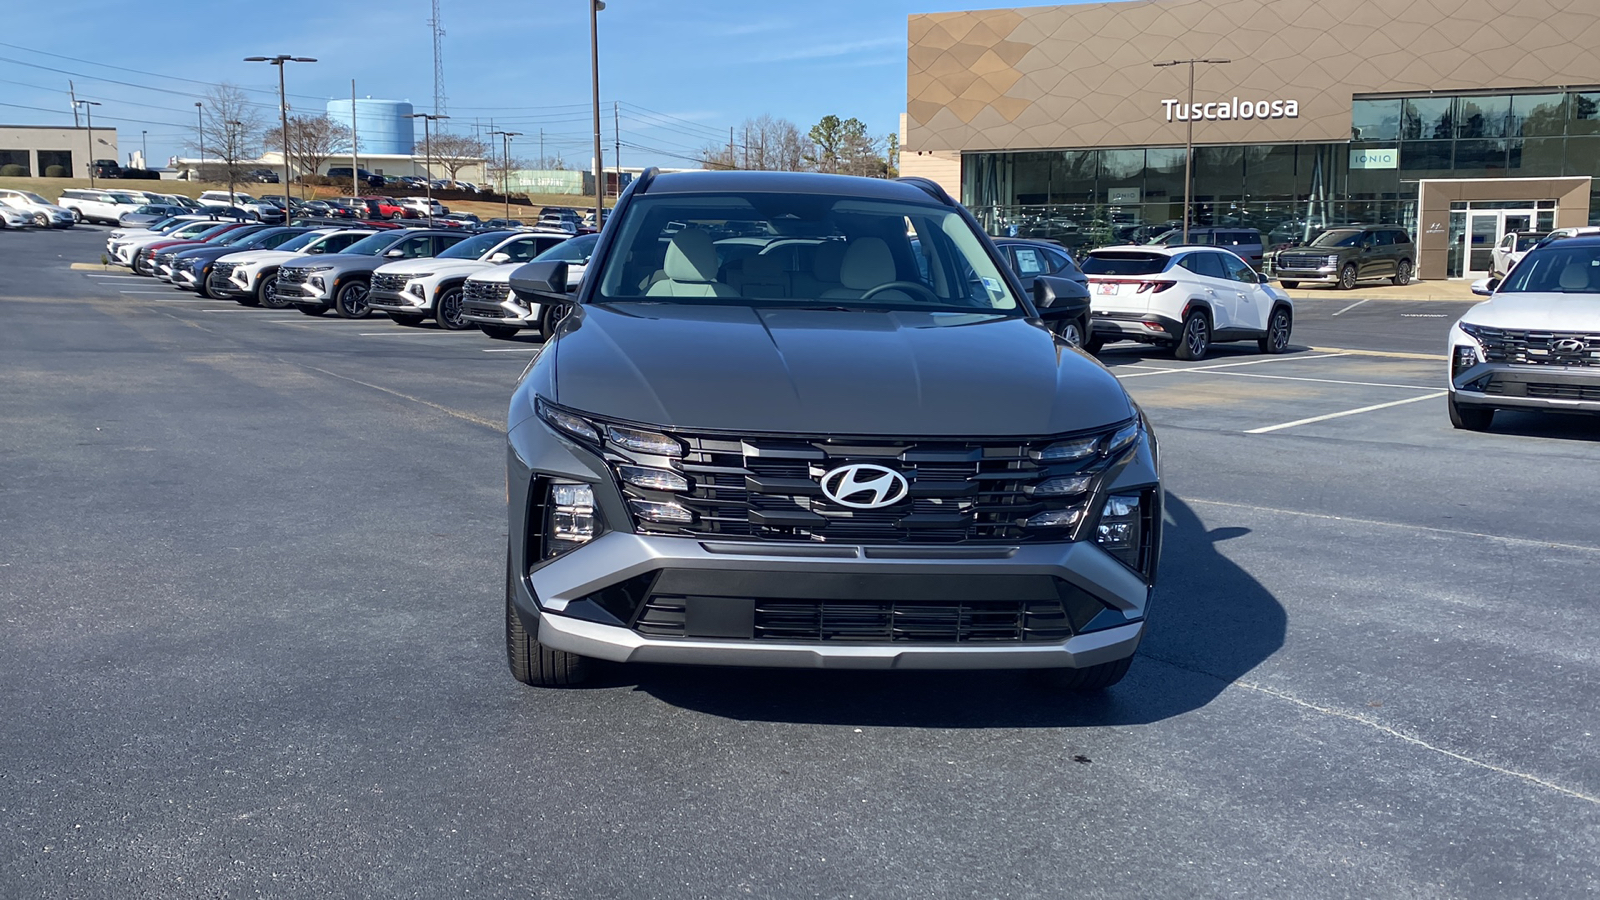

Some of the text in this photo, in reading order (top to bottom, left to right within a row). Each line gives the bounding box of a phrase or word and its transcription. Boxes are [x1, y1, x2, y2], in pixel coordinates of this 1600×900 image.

[1161, 96, 1299, 122] Tuscaloosa
[1355, 155, 1391, 163] IONIQ
[538, 177, 564, 187] SHIPPING
